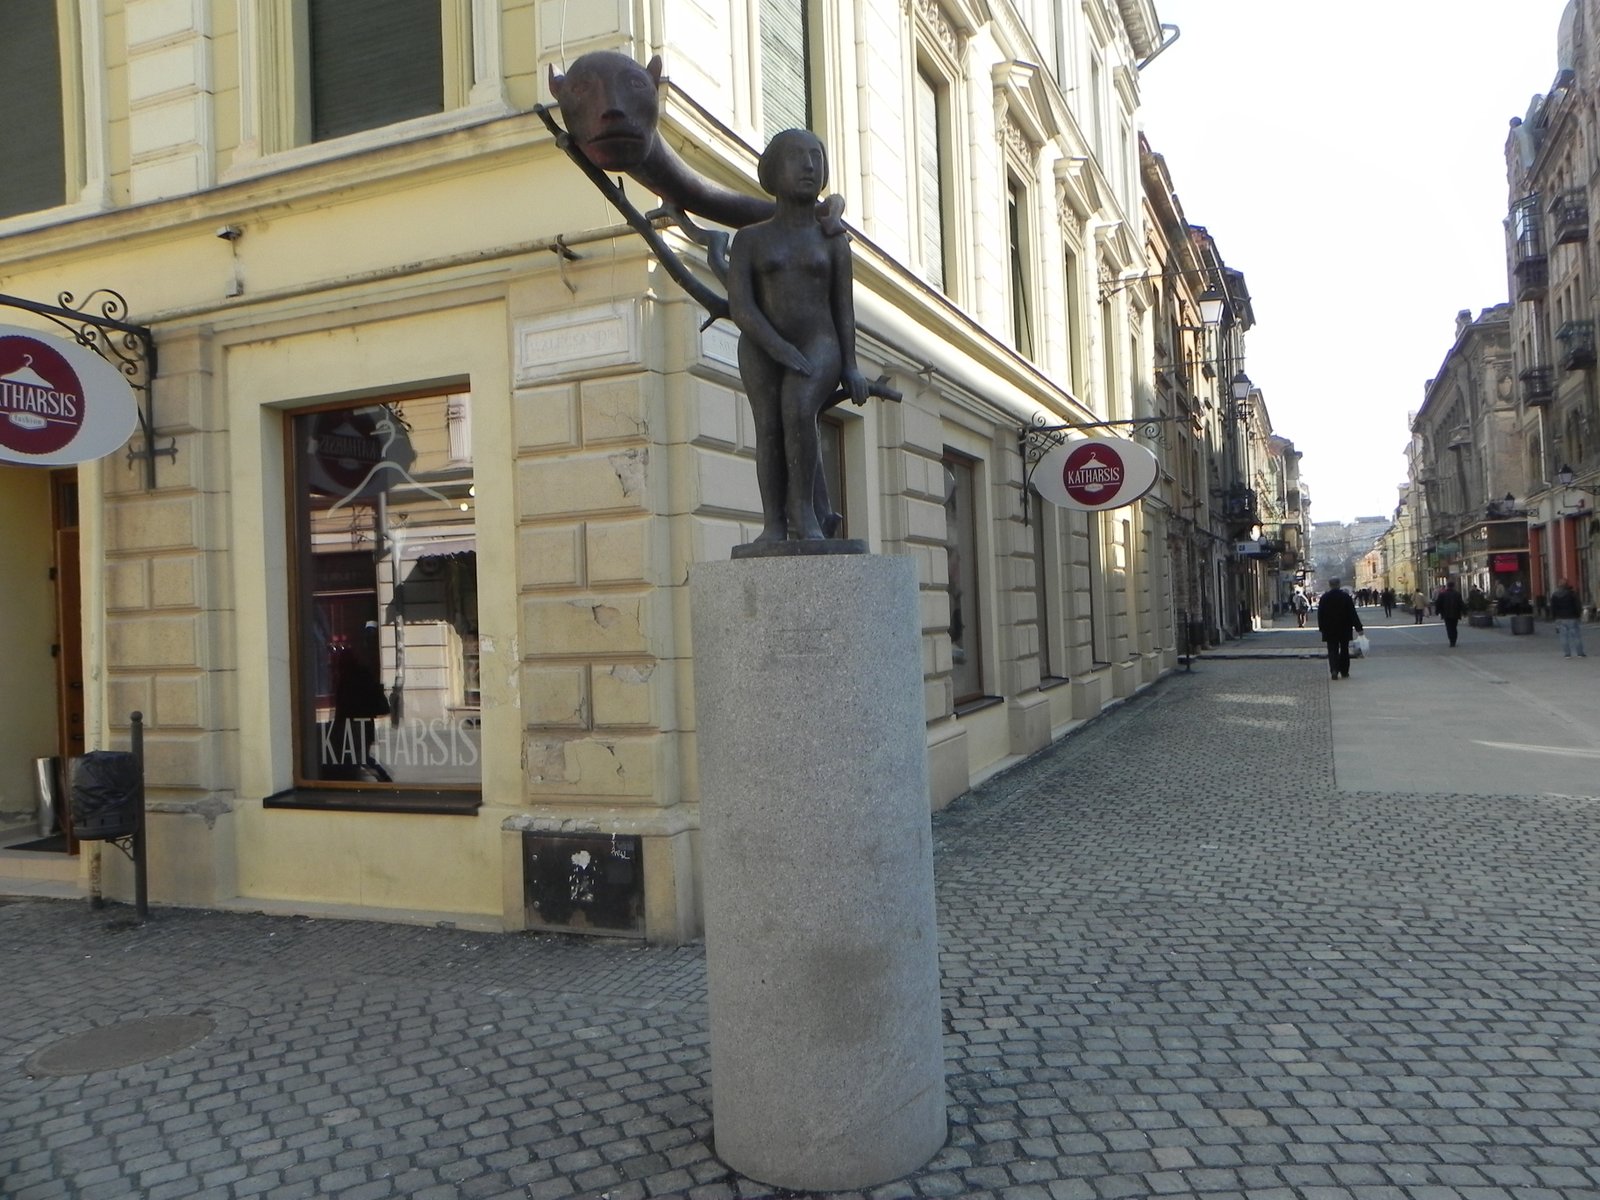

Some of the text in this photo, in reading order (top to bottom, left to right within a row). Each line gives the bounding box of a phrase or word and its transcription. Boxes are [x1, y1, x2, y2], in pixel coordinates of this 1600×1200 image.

[0, 383, 76, 417] THARSIS
[1068, 467, 1120, 484] KATHARSIS
[320, 718, 479, 766] KATHARSIS
